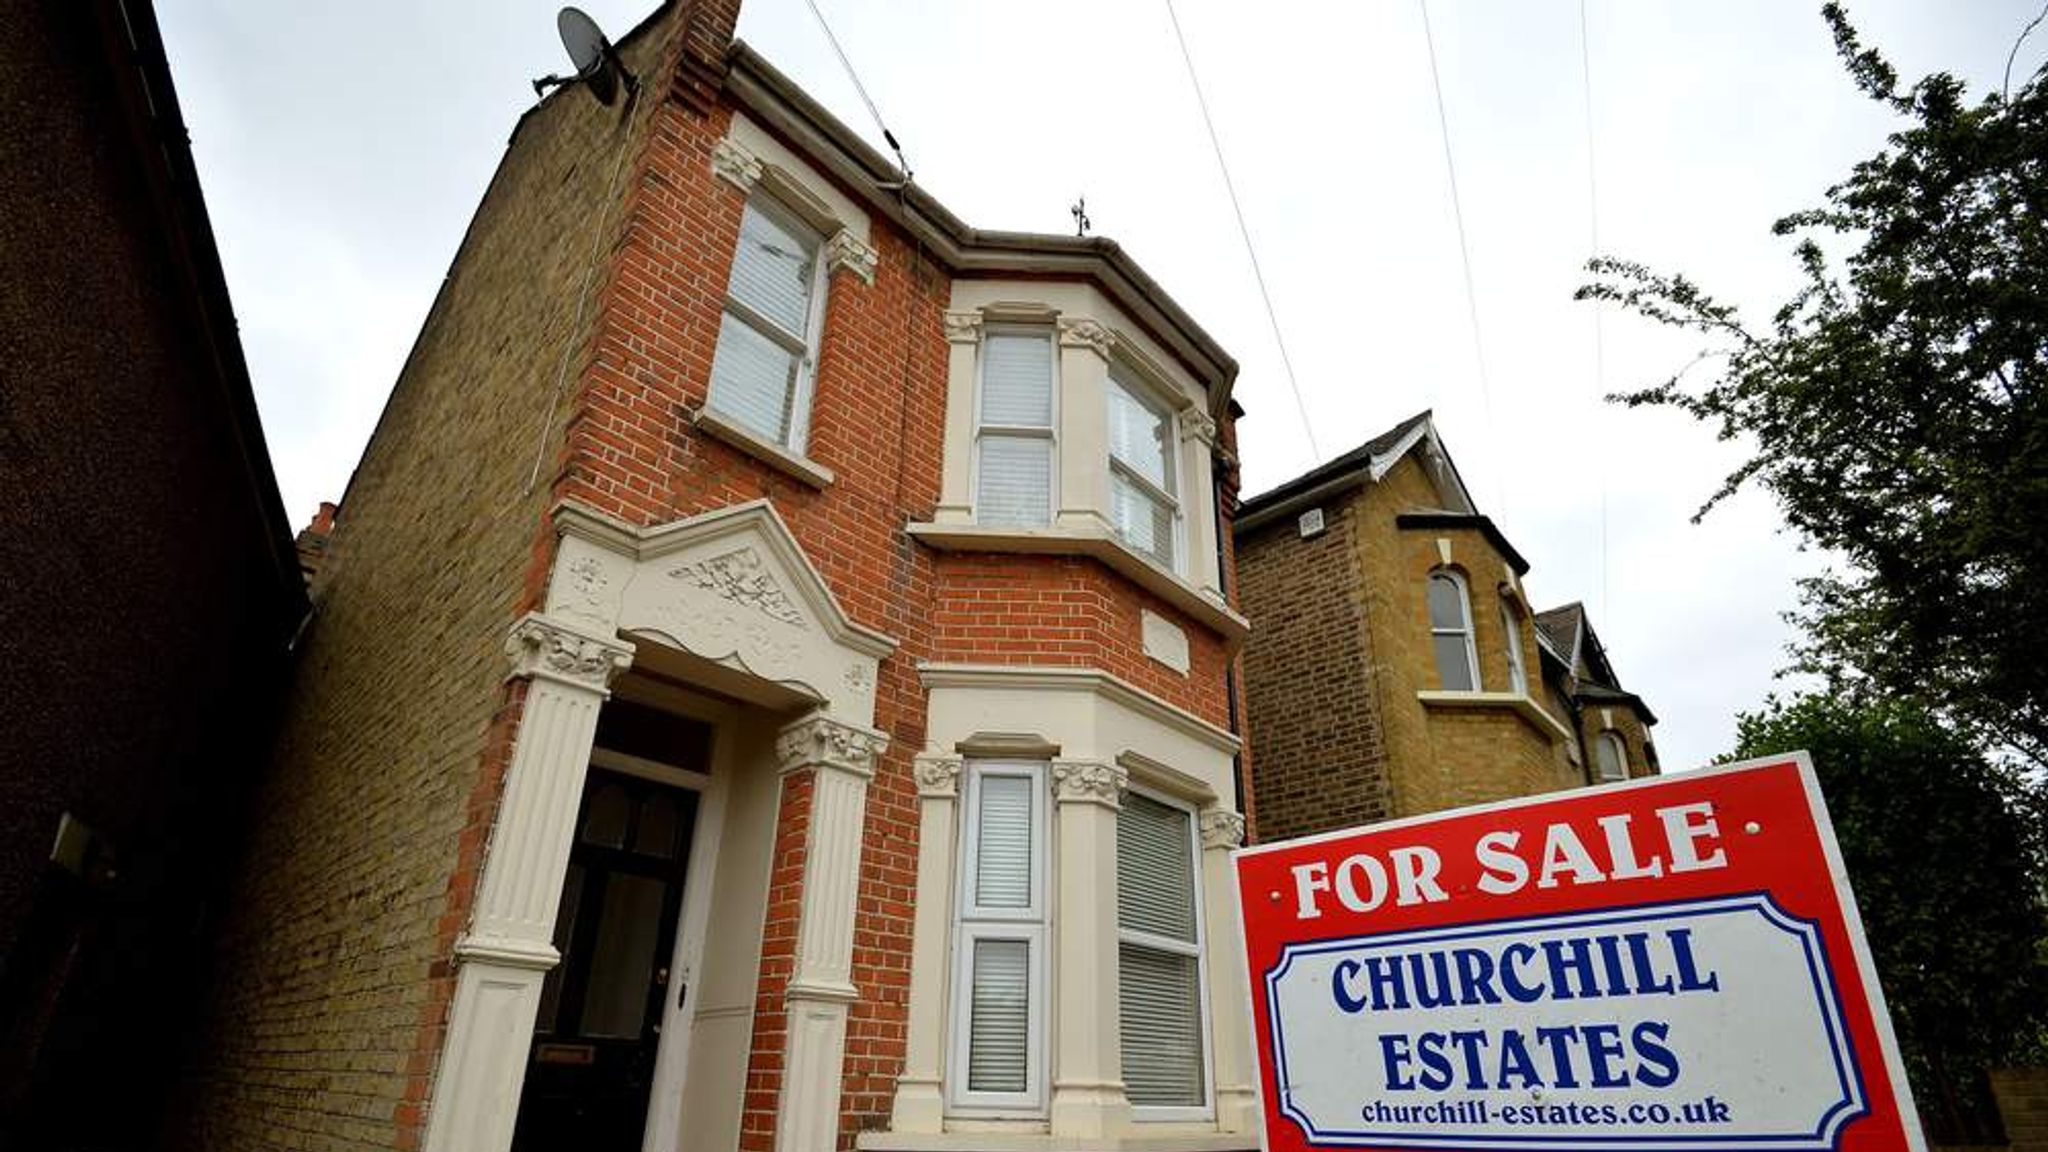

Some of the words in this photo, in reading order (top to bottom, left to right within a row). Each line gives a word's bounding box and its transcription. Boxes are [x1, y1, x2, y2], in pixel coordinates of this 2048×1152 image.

[1291, 845, 1449, 919] FOR
[1475, 801, 1728, 895] SALE
[1331, 927, 1720, 1014] CHURCHILL
[1378, 1020, 1681, 1092] ESTATES
[1361, 1096, 1731, 1126] churchill-estates.co.uk
